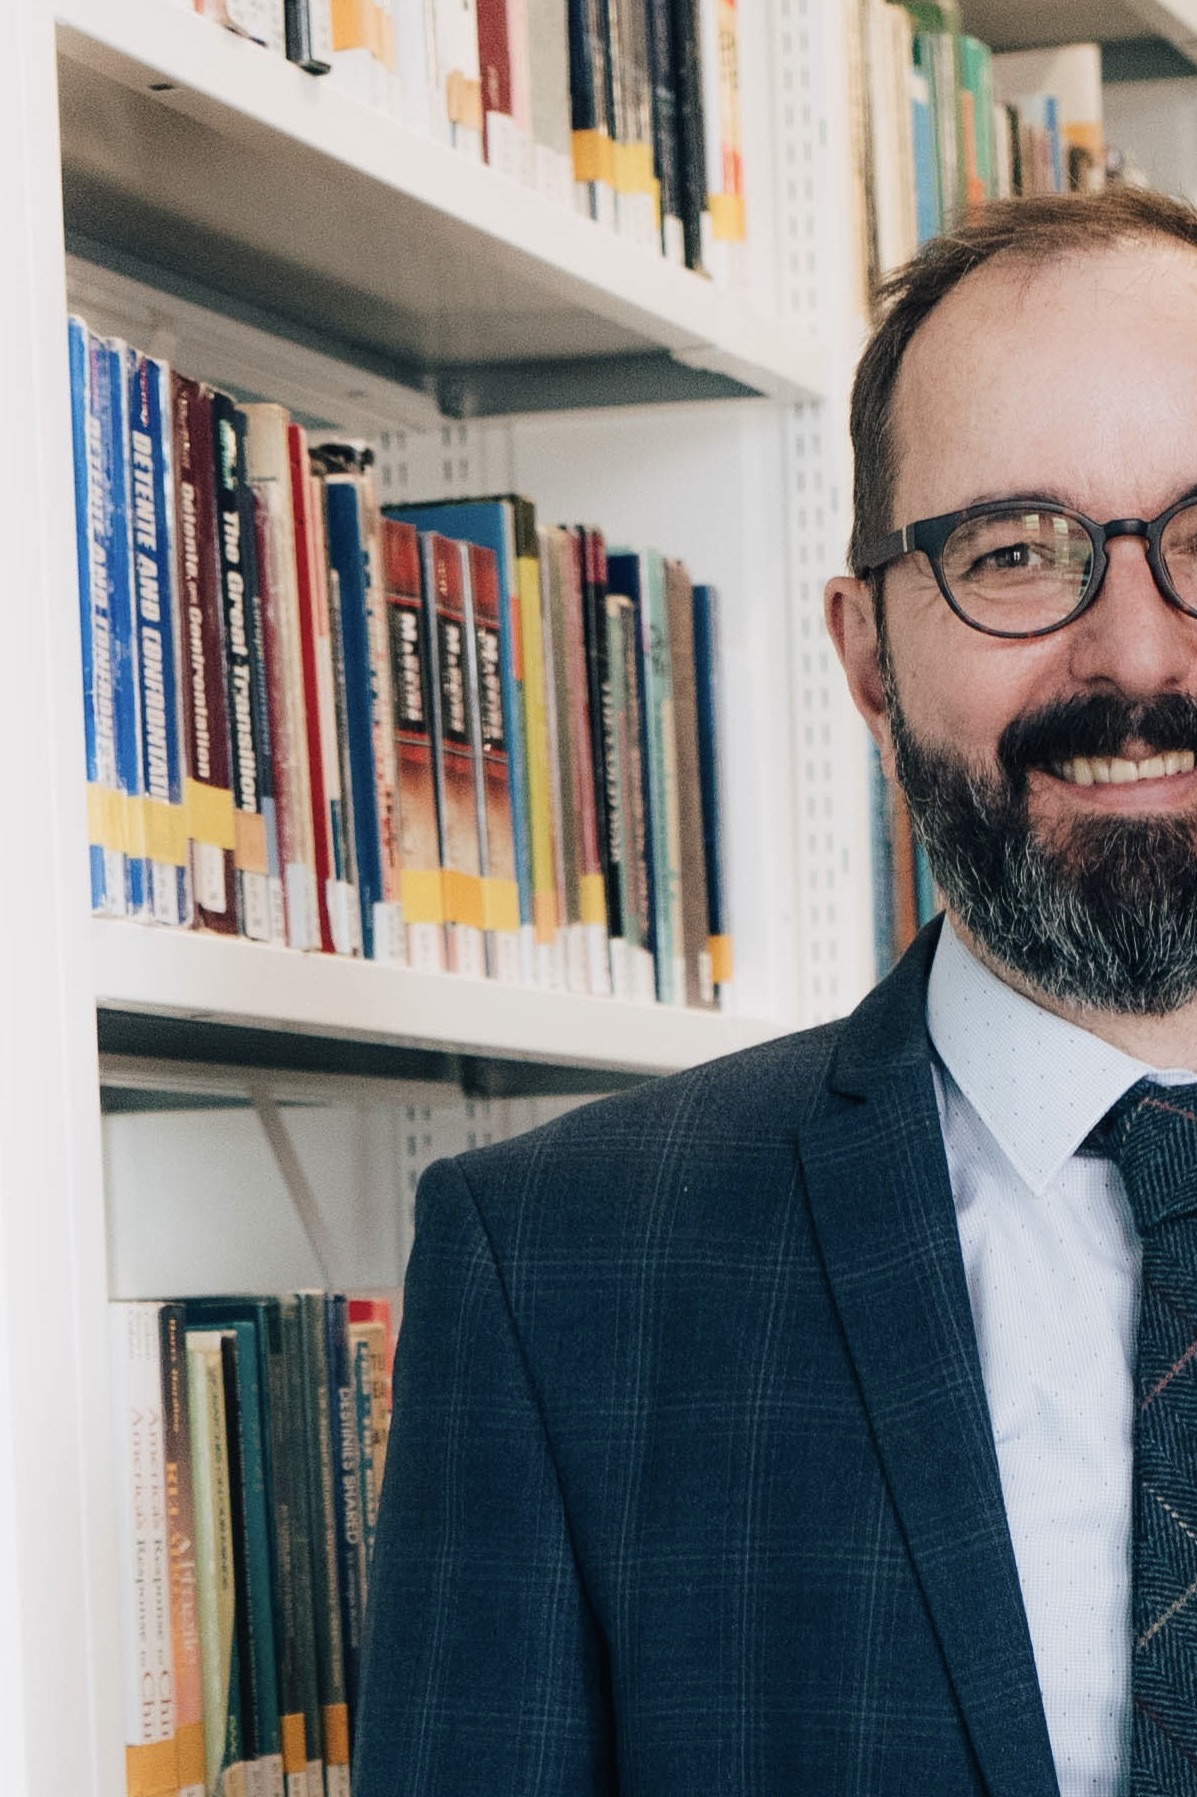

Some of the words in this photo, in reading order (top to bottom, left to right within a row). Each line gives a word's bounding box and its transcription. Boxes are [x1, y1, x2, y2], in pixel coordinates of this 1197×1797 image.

[222, 510, 241, 564] The
[137, 552, 161, 623] AND
[227, 570, 248, 657] Great
[188, 606, 210, 778] Confrontation
[233, 664, 257, 814] Transition
[343, 1477, 359, 1546] SHARED
